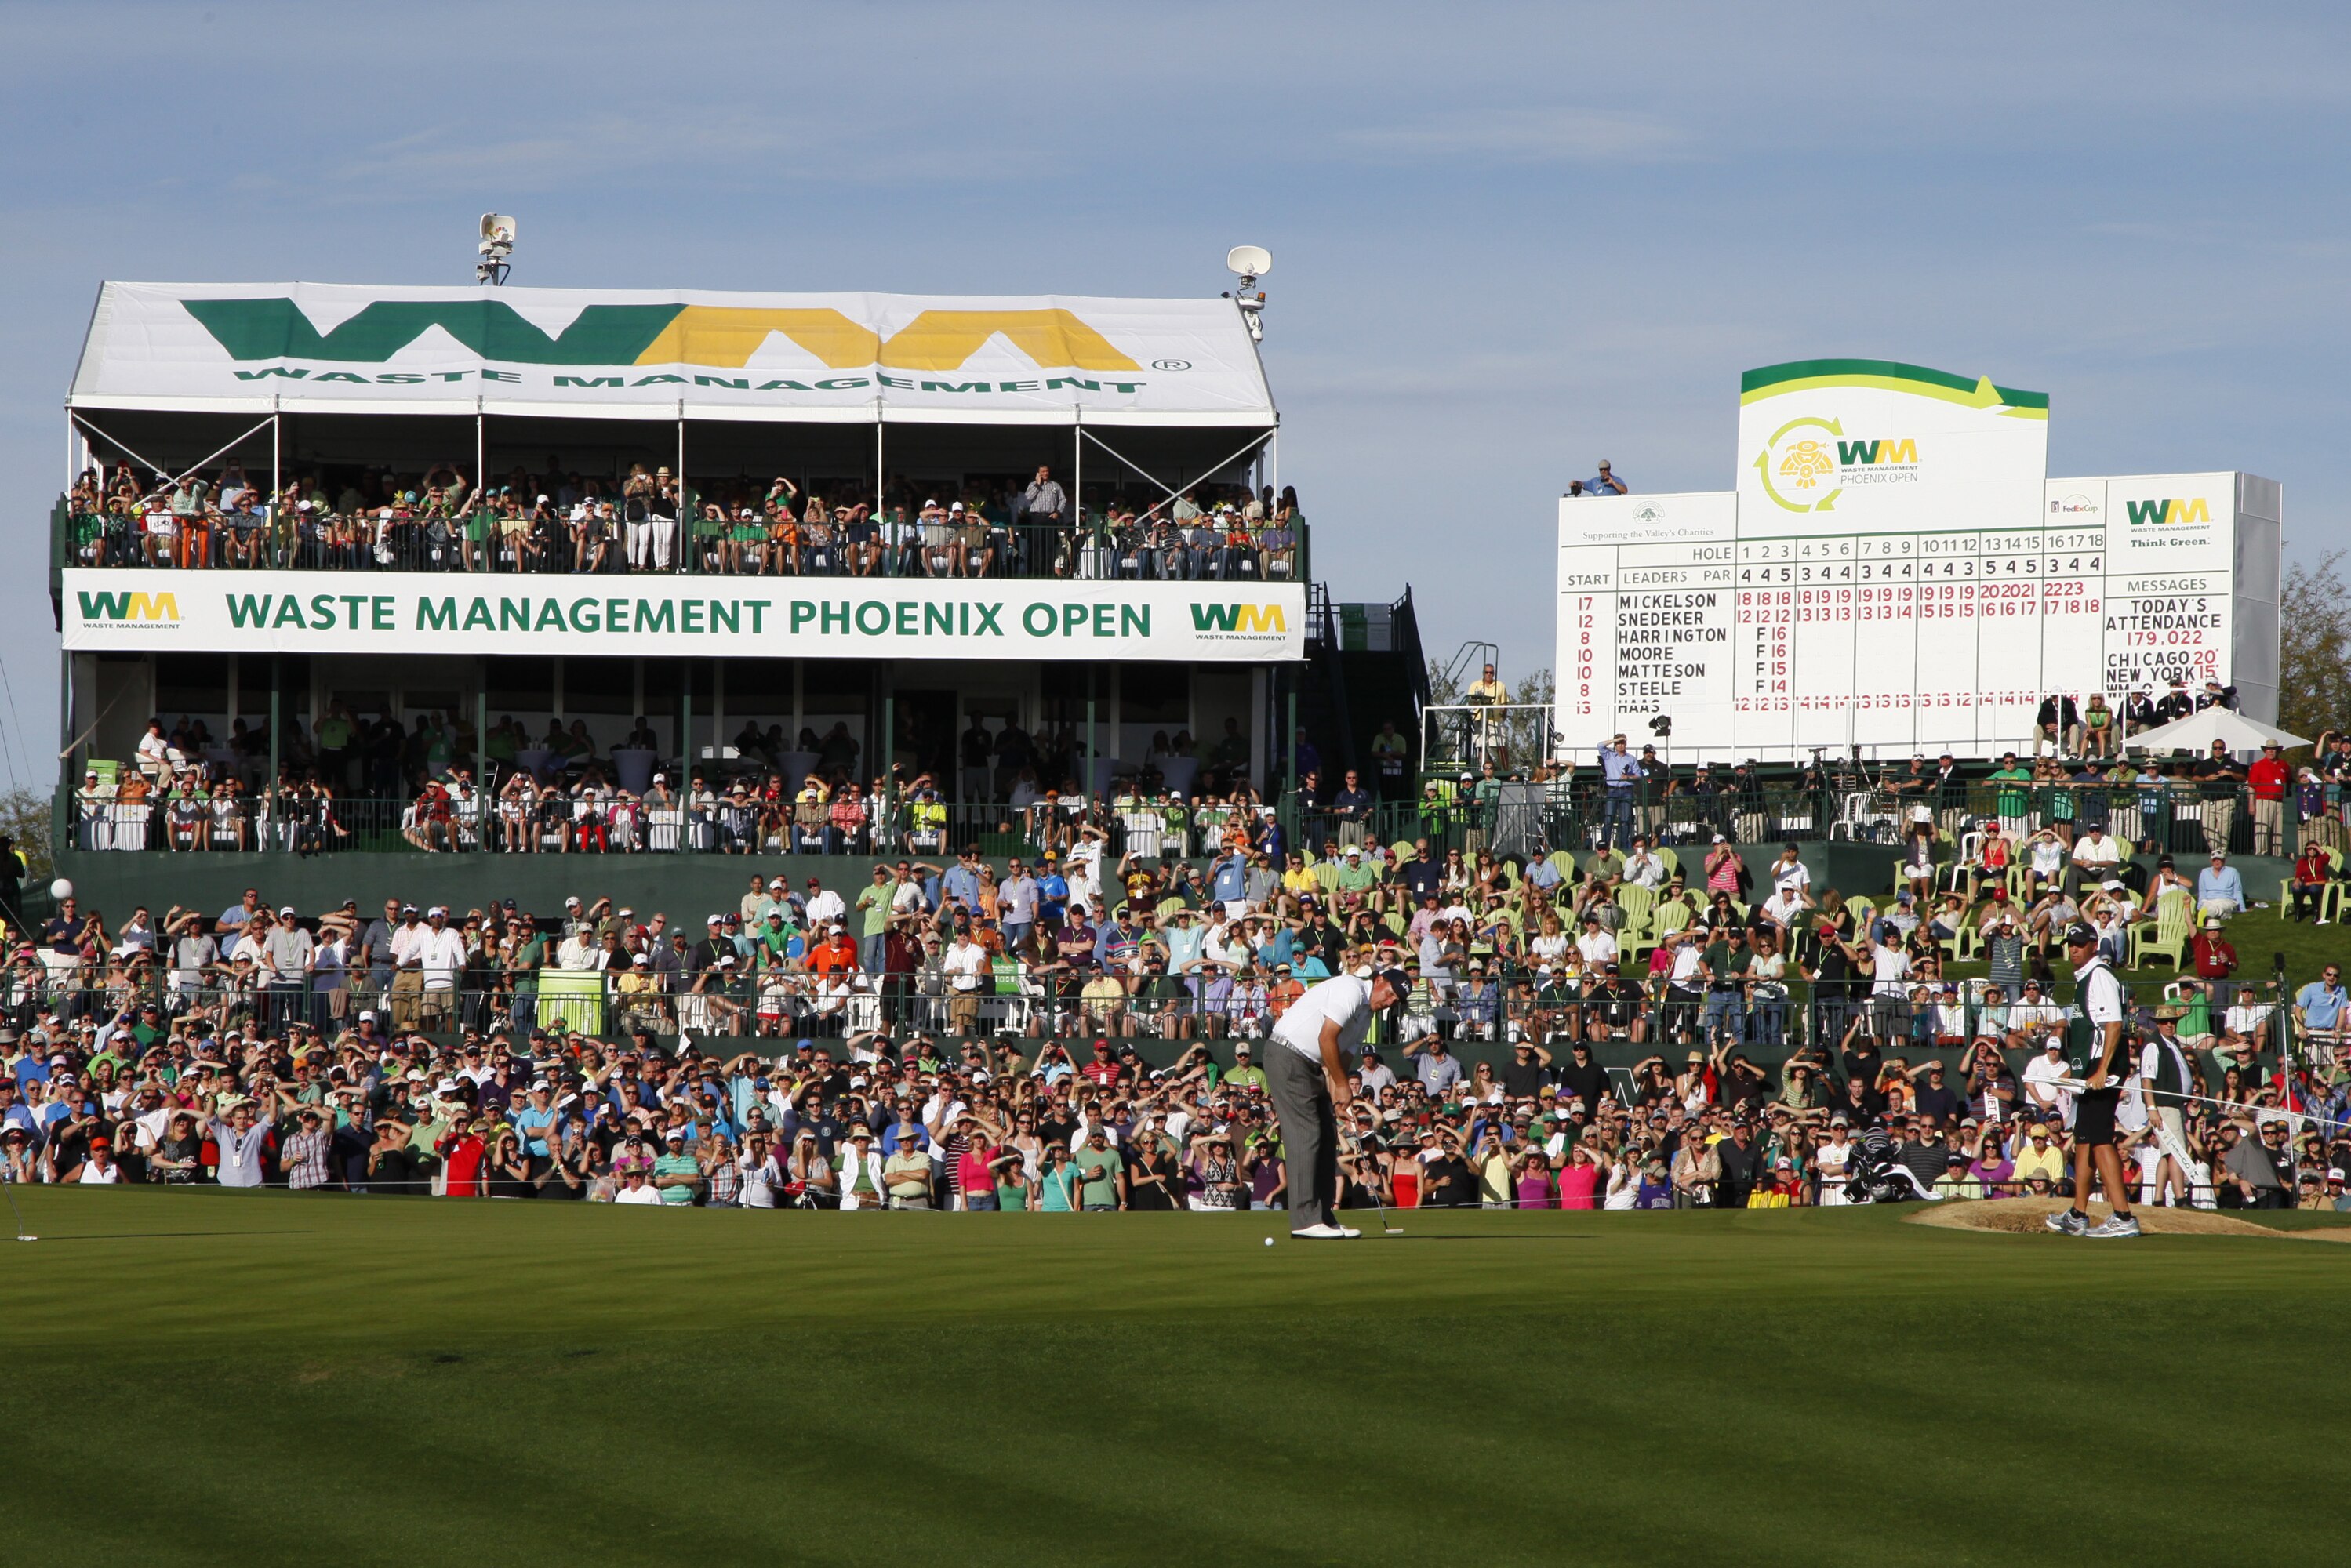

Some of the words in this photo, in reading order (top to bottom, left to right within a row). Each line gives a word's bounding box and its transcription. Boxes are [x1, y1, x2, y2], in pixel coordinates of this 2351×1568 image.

[232, 367, 524, 387] WASTE
[552, 375, 1148, 395] MANAGEMENT
[1836, 438, 1919, 466] WM
[1841, 474, 1887, 485] PHOENIX
[1889, 473, 1917, 483] OPEN
[2062, 503, 2098, 514] FedExCup
[2125, 497, 2211, 525] WM
[1583, 532, 1628, 541] Supporting
[1645, 529, 1675, 539] Valley's
[1693, 547, 1731, 560] HOLE
[1743, 547, 1749, 558] 1
[1762, 546, 1769, 557] 2
[1782, 546, 1789, 557] 3
[1802, 545, 1811, 556] 4
[1822, 544, 1830, 556] 5
[1840, 543, 1849, 555] 6
[1863, 543, 1871, 554] 7
[1882, 542, 1891, 554] 8
[1902, 541, 1910, 553] 9
[1923, 540, 1939, 552] 10
[1942, 539, 1956, 551] 11
[1962, 539, 1976, 551] 12
[1986, 538, 2000, 550] 13
[2005, 538, 2021, 550] 14
[2025, 536, 2040, 549] 15
[2048, 535, 2064, 548] 16
[2068, 535, 2084, 547] 17
[2088, 534, 2103, 546] 18
[1568, 575, 1610, 586] START
[1624, 572, 1687, 583] LEADERS
[1704, 570, 1730, 581] PAR
[1742, 569, 1750, 582] 4
[1761, 569, 1770, 582] 4
[1781, 568, 1790, 582] 5
[1802, 568, 1810, 580] 3
[1821, 567, 1830, 579] 4
[1840, 566, 1850, 579] 4
[1862, 565, 1871, 579] 3
[1882, 564, 1891, 578] 4
[1902, 564, 1911, 577] 4
[1924, 564, 1932, 576] 4
[1944, 563, 1953, 575] 4
[1964, 562, 1973, 575] 3
[1986, 561, 1996, 574] 5
[2006, 561, 2015, 573] 4
[2026, 560, 2036, 573] 5
[2050, 559, 2058, 572] 3
[2069, 558, 2078, 571] 4
[2090, 557, 2099, 571] 4
[2128, 579, 2207, 591] MESSAGES
[1579, 597, 1592, 610] 17
[1620, 593, 1716, 609] MICKELSON
[1738, 593, 1751, 605] 18
[1757, 592, 1771, 605] 18
[1777, 592, 1790, 604] 18
[1798, 591, 1811, 604] 18
[1817, 590, 1830, 604] 19
[1837, 590, 1851, 603] 19
[1859, 589, 1873, 602] 19
[1878, 588, 1892, 601] 19
[1898, 588, 1912, 601] 19
[1920, 587, 1934, 601] 19
[1940, 586, 1954, 600] 19
[1960, 586, 1974, 599] 19
[1979, 583, 2000, 599] 20
[2001, 584, 2021, 597] 20
[2022, 583, 2034, 597] 21
[2044, 583, 2062, 597] 22
[2064, 582, 2084, 596] 23
[77, 591, 179, 620] WM
[226, 594, 394, 630] WASTE
[416, 597, 771, 633] MANAGEMENT
[790, 601, 1004, 636] PHOENIX
[1023, 602, 1150, 637] OPEN
[1190, 604, 1286, 632] WM
[1579, 615, 1593, 628] 12
[1619, 612, 1703, 626] SNEDEKER
[1738, 610, 1751, 623] 12
[1757, 610, 1770, 623] 12
[1776, 609, 1790, 622] 12
[1797, 608, 1811, 622] 13
[1816, 608, 1830, 621] 13
[1837, 607, 1850, 621] 13
[1858, 607, 1872, 620] 13
[1878, 605, 1891, 619] 13
[1898, 606, 1911, 619] 14
[1920, 604, 1934, 618] 15
[1939, 604, 1953, 618] 15
[1960, 604, 1974, 617] 15
[1979, 601, 1995, 616] 16
[2001, 602, 2015, 615] 16
[2022, 601, 2036, 615] 17
[2043, 599, 2059, 615] 17
[2066, 600, 2080, 613] 18
[2085, 599, 2099, 613] 18
[2106, 614, 2221, 630] ATTENDANCE
[1581, 632, 1590, 644] 8
[1619, 628, 1726, 644] HARRINGTON
[1757, 627, 1765, 641] F
[1772, 626, 1786, 640] 16
[2127, 630, 2203, 647] 179,022
[1579, 648, 1592, 662] 10
[1620, 647, 1673, 661] MOORE
[1757, 644, 1765, 658] F
[1772, 644, 1786, 657] 16
[2108, 651, 2189, 667] CHICAGO
[1578, 666, 1592, 680] 10
[1619, 664, 1705, 678] MATTESON
[1757, 662, 1764, 675] F
[1772, 662, 1786, 675] 15
[2106, 669, 2141, 683] NEW
[2150, 666, 2195, 681] YORK
[1581, 684, 1589, 696] 8
[1619, 681, 1681, 696] STEELE
[1756, 680, 1764, 693] F
[1772, 680, 1786, 693] 14
[1577, 701, 1590, 714] 13
[1619, 699, 1659, 713] HAAS
[1734, 697, 1750, 711] 12
[1756, 698, 1769, 711] 12
[1775, 697, 1789, 710] 13
[1815, 696, 1830, 710] 14
[1857, 695, 1870, 709] 13
[1877, 695, 1890, 708] 13
[1896, 694, 1910, 708] 13
[1938, 693, 1950, 706] 13
[1957, 693, 1971, 706] 12
[1979, 692, 1993, 706] 14
[2000, 691, 2014, 705] 14
[2020, 691, 2034, 705] 14
